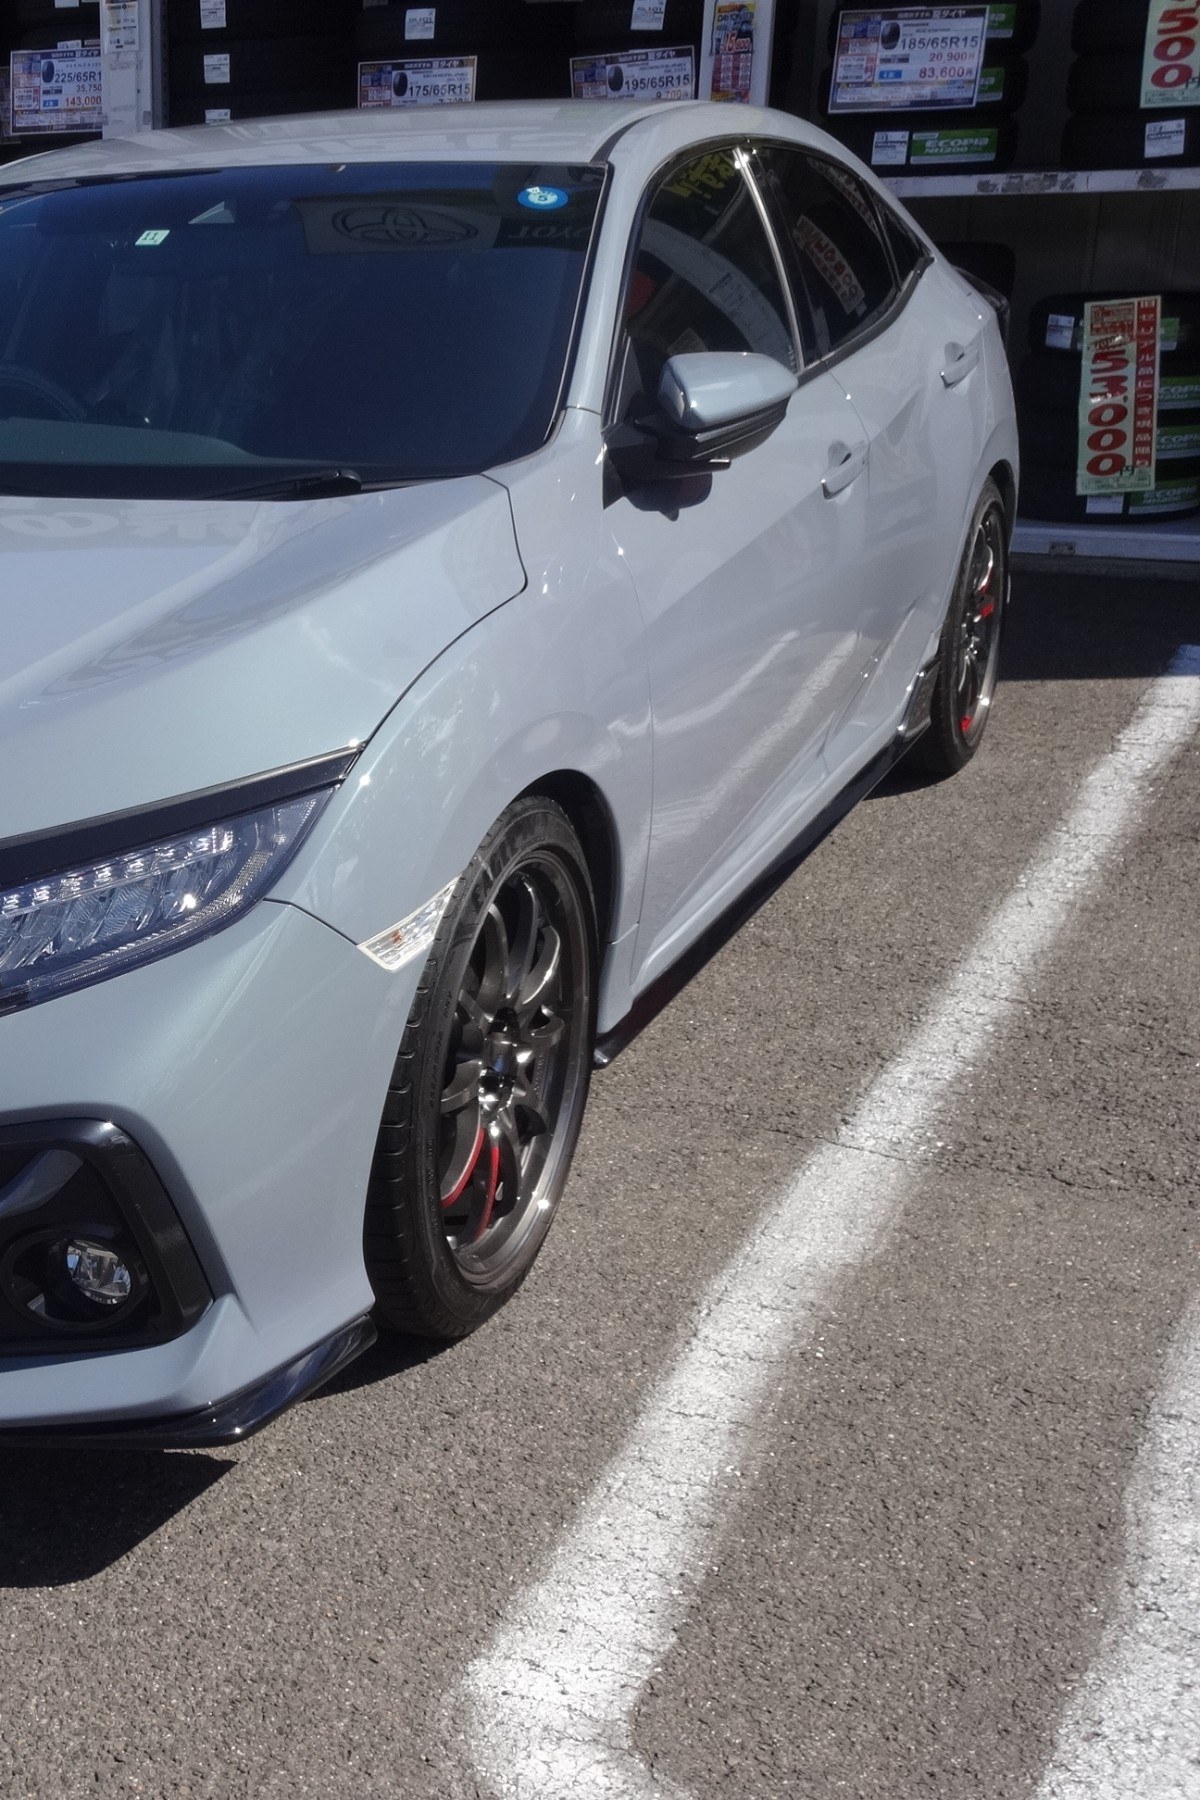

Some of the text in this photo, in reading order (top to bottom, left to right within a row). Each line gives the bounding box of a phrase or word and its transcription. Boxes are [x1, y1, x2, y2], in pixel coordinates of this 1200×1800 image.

[900, 35, 979, 50] 185/65R15
[928, 52, 976, 62] 20,900円
[55, 72, 102, 83] 225/65R1
[919, 67, 973, 79] 83,600円
[624, 75, 690, 91] 195/65R15
[408, 84, 472, 97] 175/65R15
[65, 96, 102, 106] 143,000
